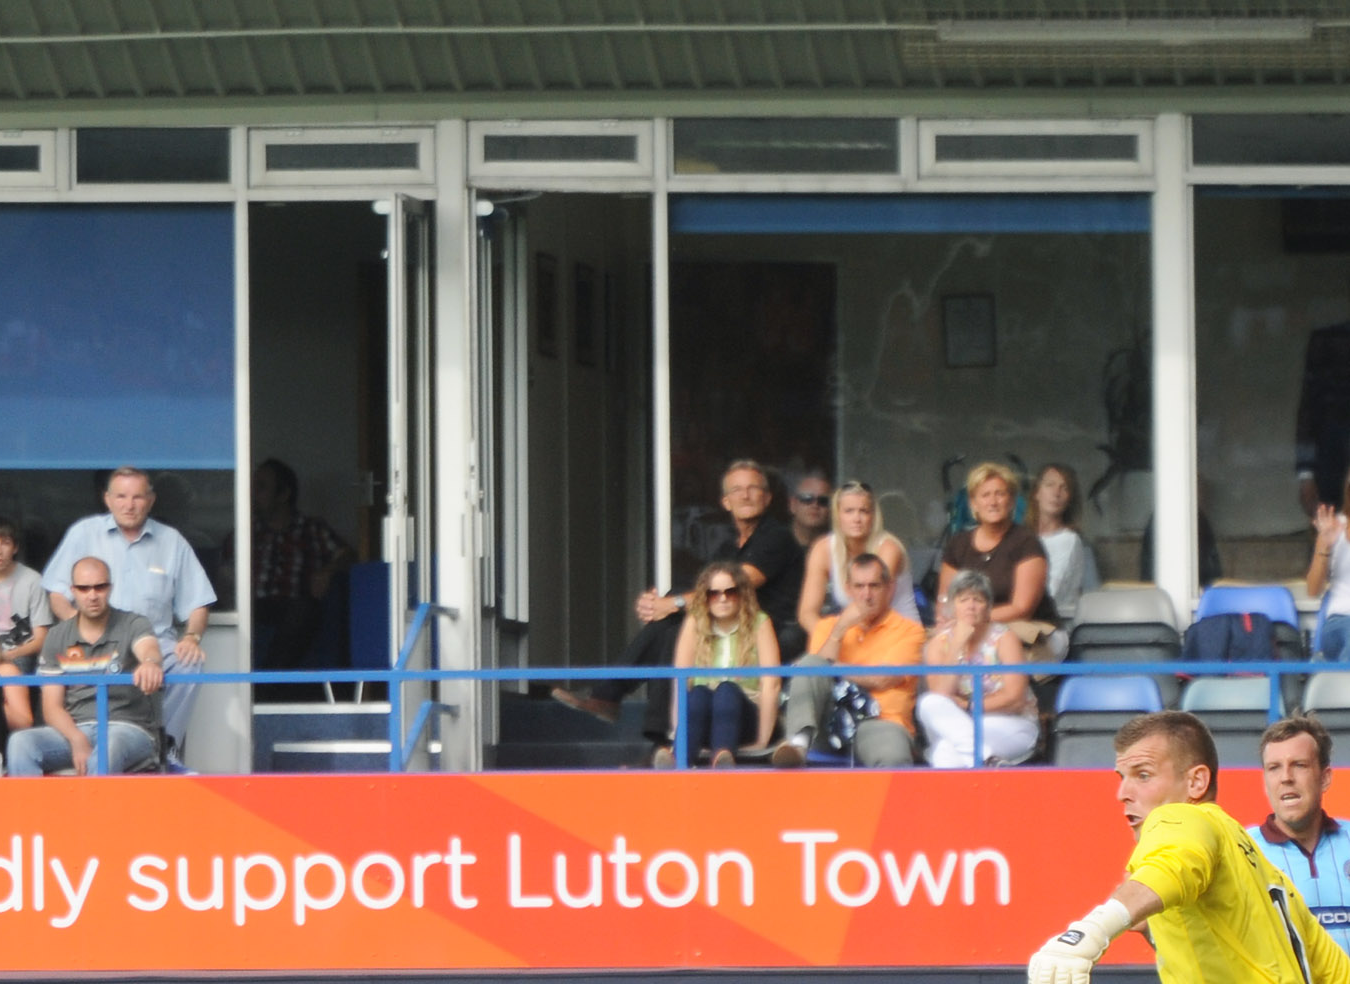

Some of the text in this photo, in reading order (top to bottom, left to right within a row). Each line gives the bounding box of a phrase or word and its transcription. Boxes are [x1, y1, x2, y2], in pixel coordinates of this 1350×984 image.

[128, 834, 479, 926] support
[507, 833, 753, 909] Luton
[781, 831, 1012, 907] Town
